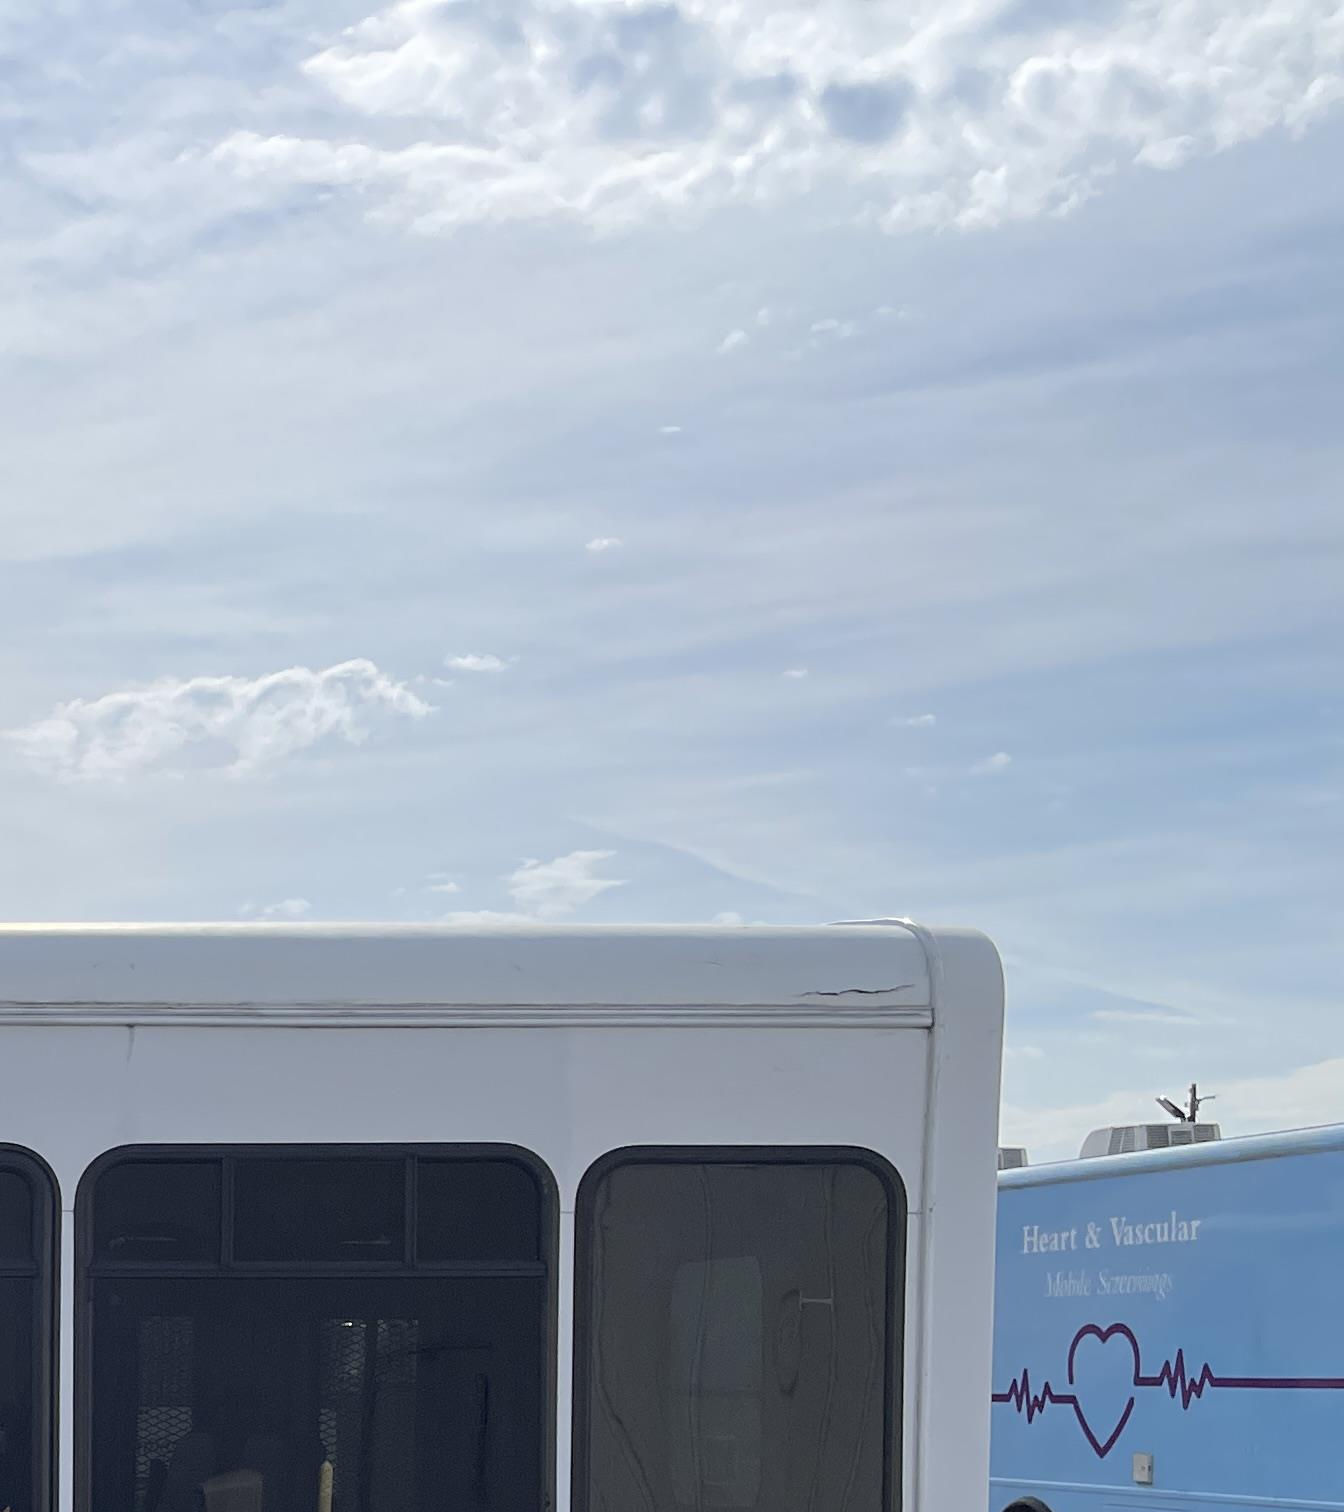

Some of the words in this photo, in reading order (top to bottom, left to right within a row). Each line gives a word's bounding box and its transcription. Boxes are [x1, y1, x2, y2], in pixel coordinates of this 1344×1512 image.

[1022, 1225, 1078, 1254] Heart
[1085, 1221, 1102, 1249] &
[1109, 1210, 1201, 1247] Vascular
